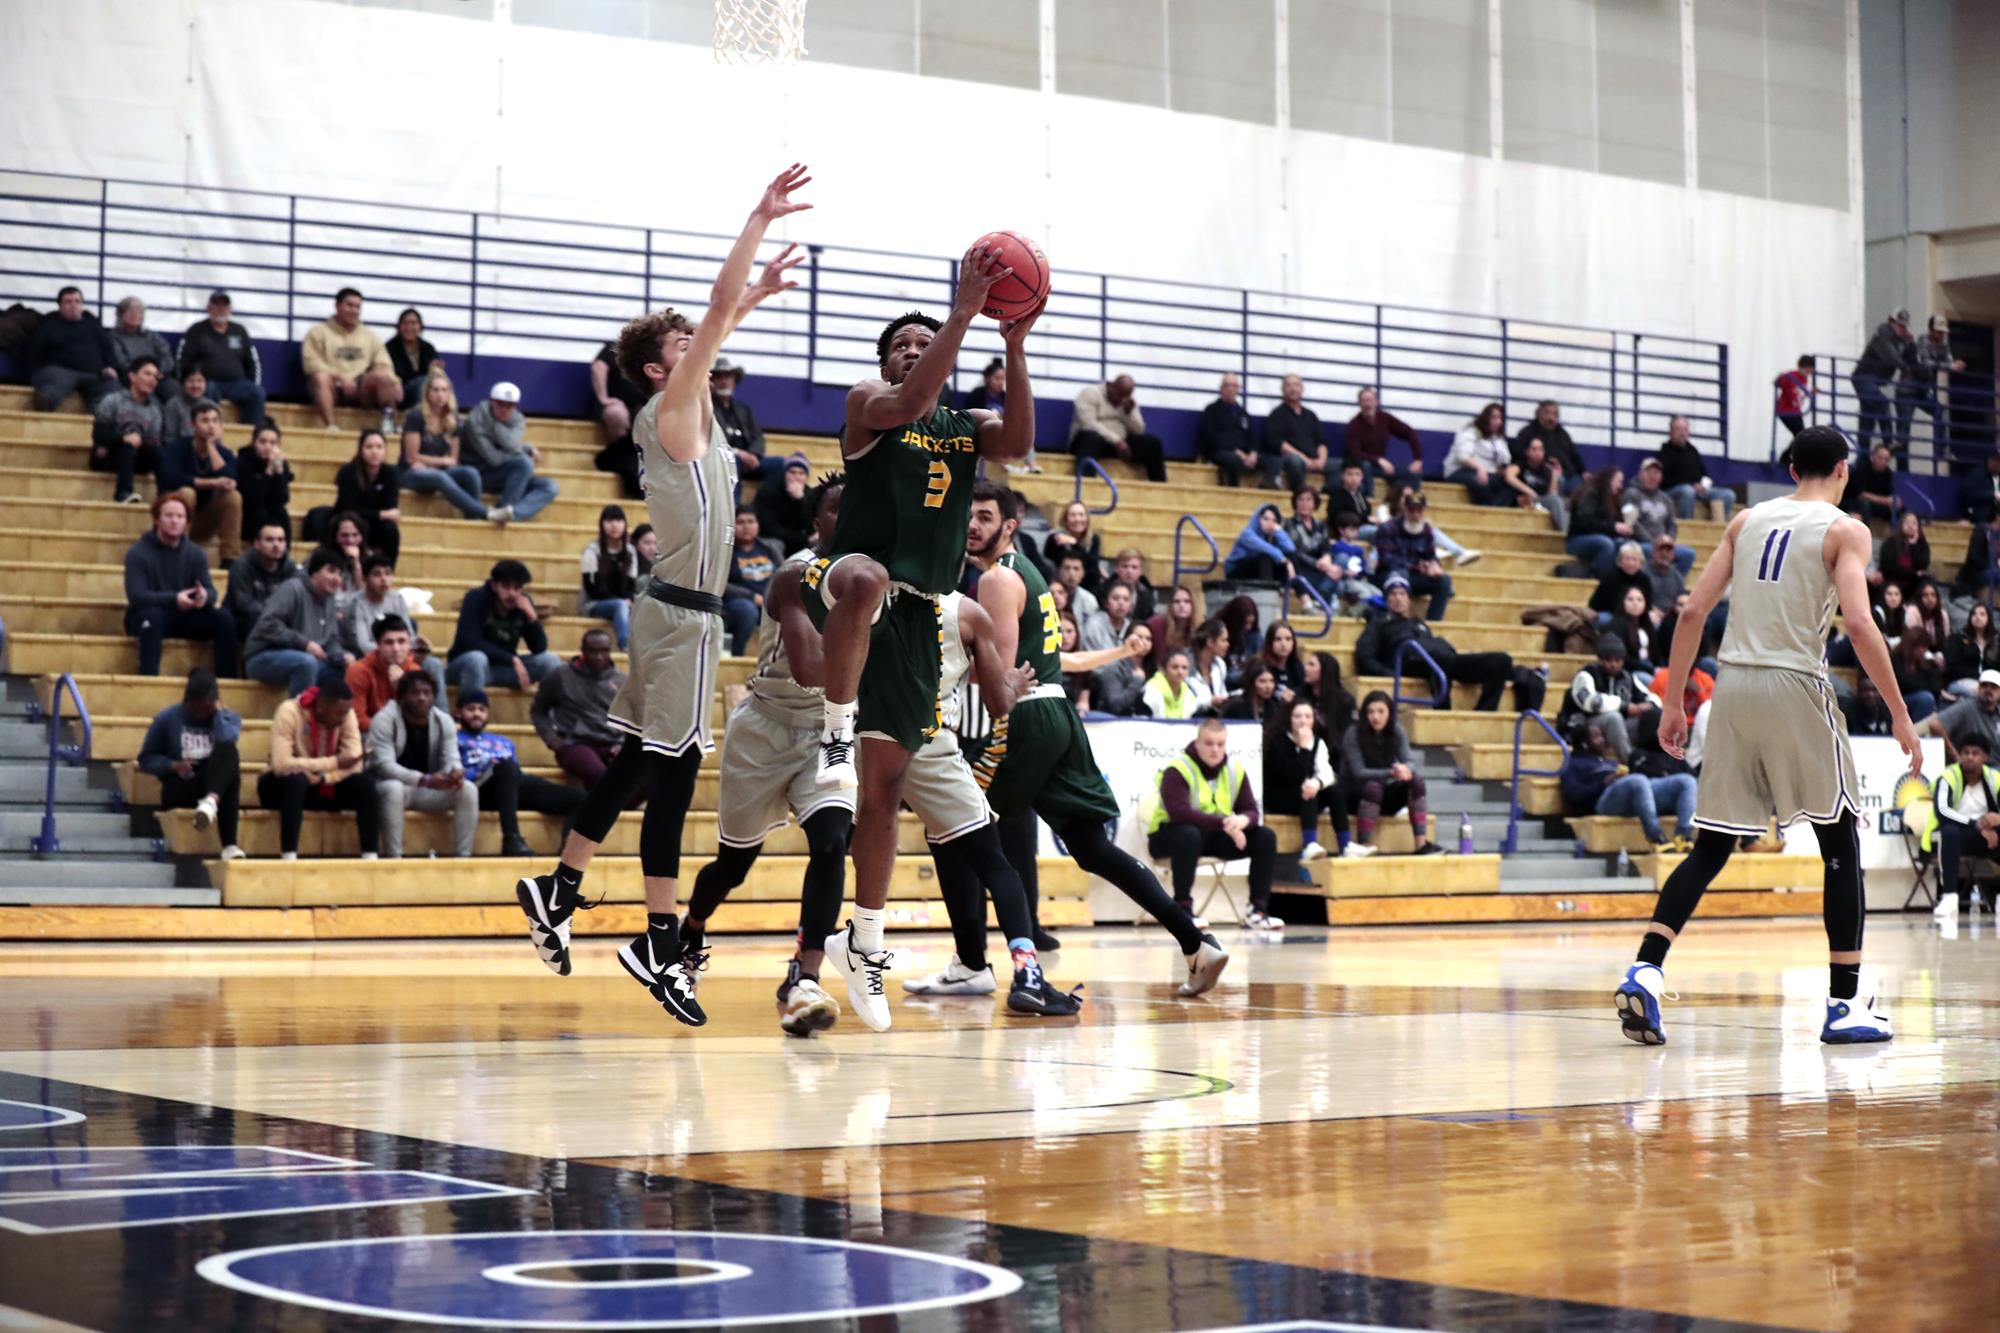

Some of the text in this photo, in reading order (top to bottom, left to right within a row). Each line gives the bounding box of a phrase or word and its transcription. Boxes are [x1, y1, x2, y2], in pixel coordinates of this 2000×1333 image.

[900, 430, 975, 453] JACKETS
[923, 459, 952, 508] 3
[1756, 527, 1794, 584] 11
[1024, 966, 1042, 990] E
